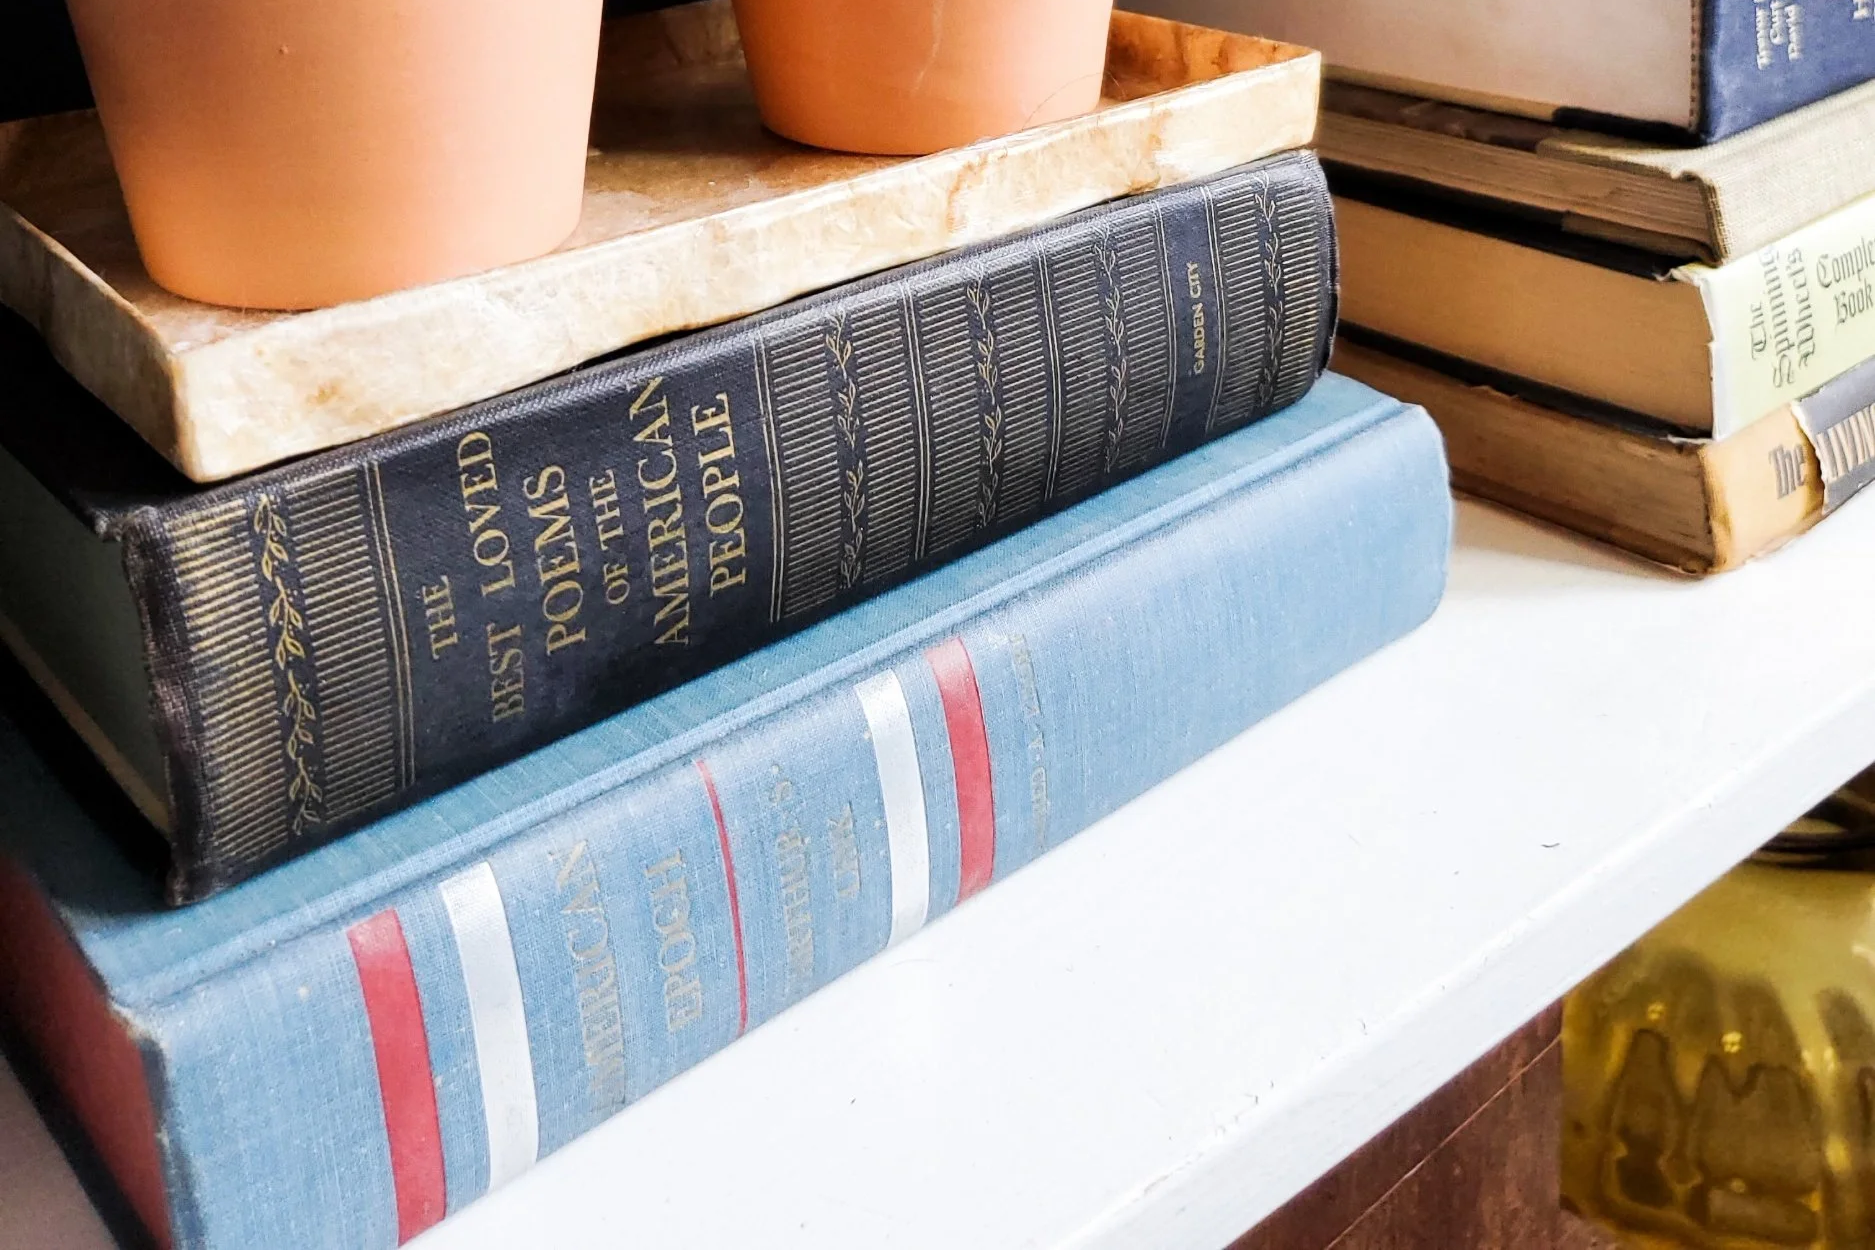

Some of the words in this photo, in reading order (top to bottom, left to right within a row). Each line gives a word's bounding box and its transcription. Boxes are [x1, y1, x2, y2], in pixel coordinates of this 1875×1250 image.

[1187, 261, 1201, 298] CITY
[1816, 236, 1875, 289] Comple
[1833, 278, 1874, 328] Book
[1192, 302, 1205, 374] GARDEN
[1749, 299, 1767, 361] The
[1757, 245, 1795, 389] Spinning
[589, 469, 624, 551] THE
[630, 376, 690, 646] AMERICAN
[692, 392, 746, 598] PEOPLE
[1768, 442, 1807, 500] The
[457, 431, 517, 597] LOVED
[523, 465, 587, 655] POEMS
[604, 562, 631, 605] OF
[422, 575, 458, 660] THE
[486, 623, 525, 723] BEST
[644, 847, 702, 1033] EPOCH
